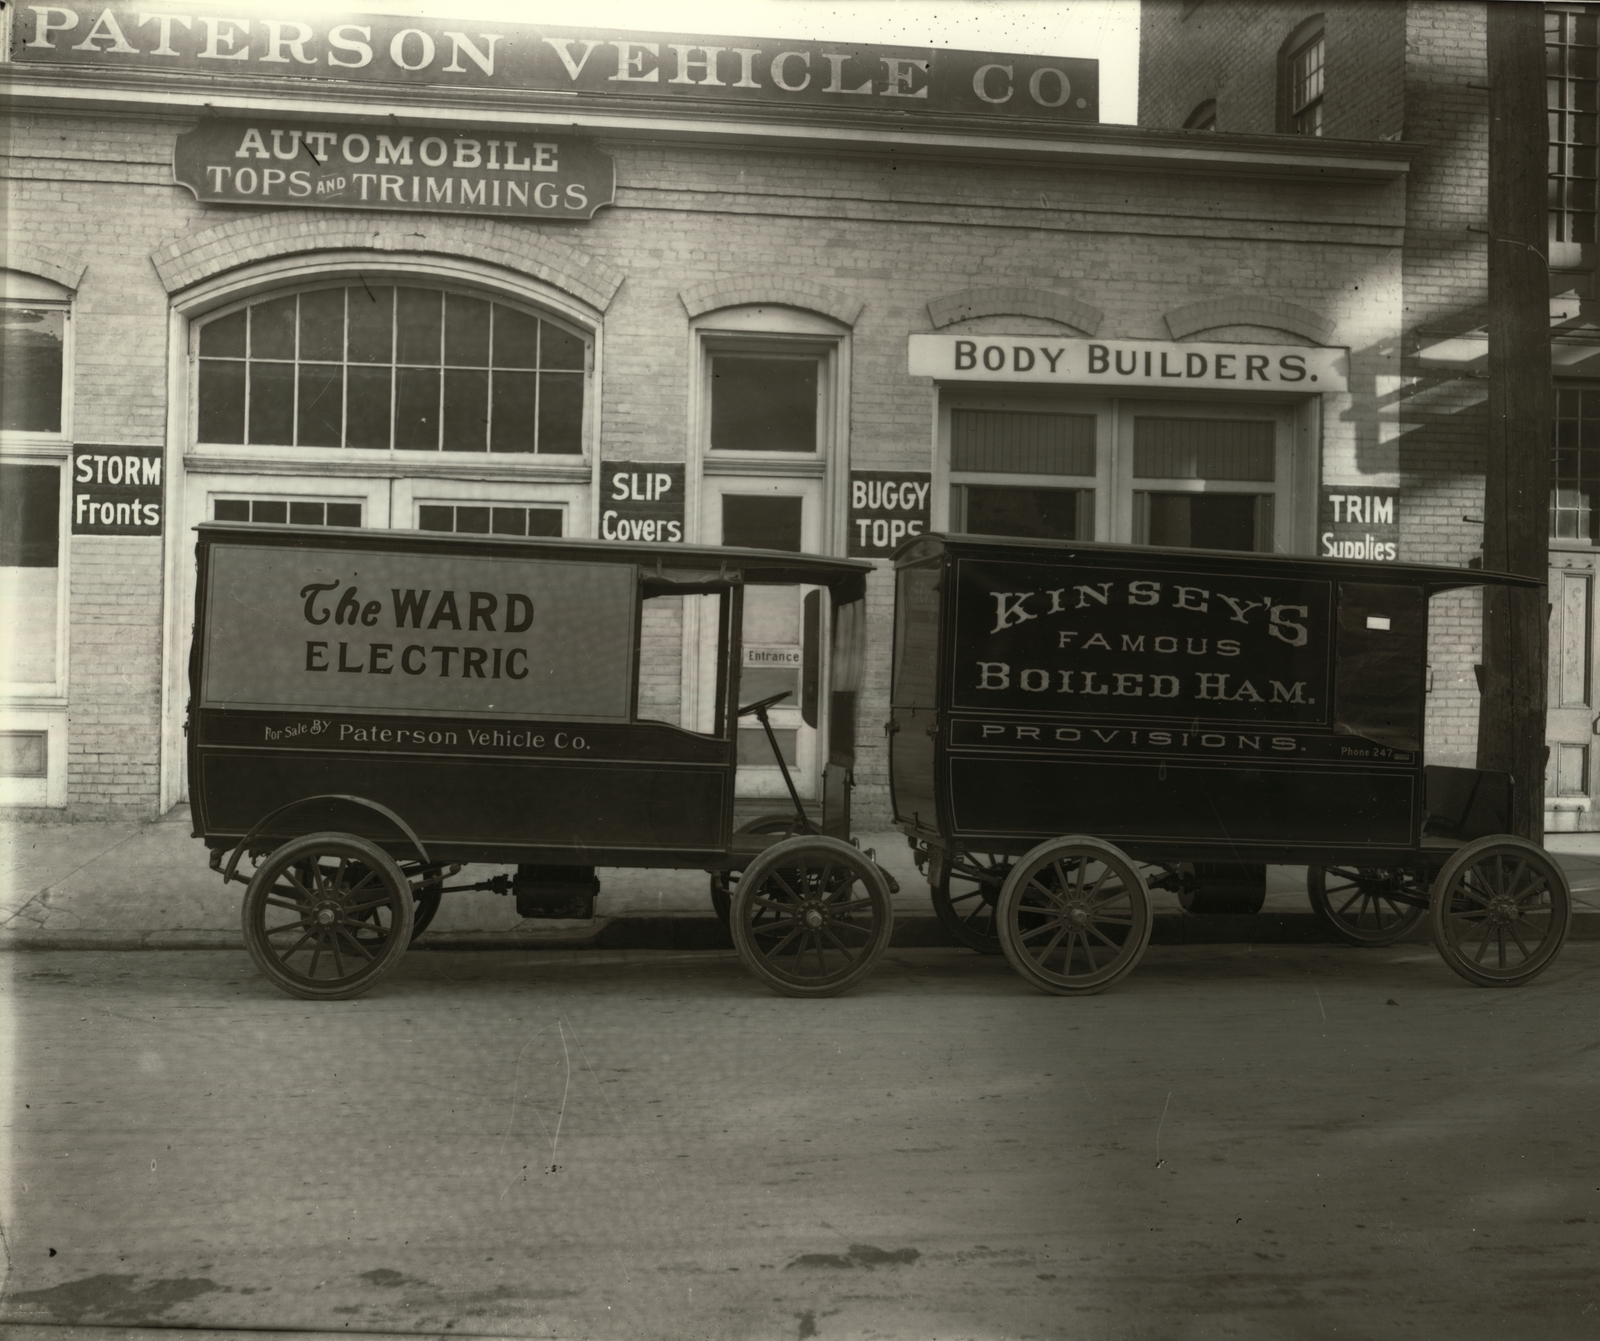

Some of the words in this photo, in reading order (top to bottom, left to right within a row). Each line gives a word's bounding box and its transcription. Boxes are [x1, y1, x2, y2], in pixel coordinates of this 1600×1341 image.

[26, 5, 504, 77] PATERSON
[541, 37, 929, 99] VEHICLE
[971, 63, 1087, 109] CO.
[234, 127, 559, 173] AUTOMOBILE
[206, 165, 312, 197] TOPS
[316, 177, 346, 193] AND
[352, 172, 588, 210] TRIMMINGS
[954, 340, 1065, 373] BODY
[1087, 343, 1318, 383] BUILDERS.
[76, 454, 161, 486] STORM
[611, 472, 672, 501] SLIP
[852, 480, 930, 511] BUGGY
[76, 494, 159, 525] Fronts
[1328, 494, 1393, 524] TRIM
[602, 510, 682, 542] Covers
[300, 579, 382, 627] The
[390, 588, 535, 633] WARD
[989, 580, 1309, 647] KINSEY'S
[749, 650, 800, 662] Entrance
[1058, 630, 1241, 656] FAMOUS
[304, 640, 530, 680] ELECTRIC
[975, 661, 1180, 698] BOILED
[1194, 672, 1316, 705] HAM.
[264, 726, 283, 741] For
[284, 723, 308, 738] Sale
[338, 724, 458, 745] Paterson
[467, 728, 546, 748] Vehicle
[553, 732, 591, 750] Co.
[981, 724, 1307, 752] PROVISIONS.
[1341, 746, 1370, 757] Phone
[1373, 747, 1393, 758] 247
